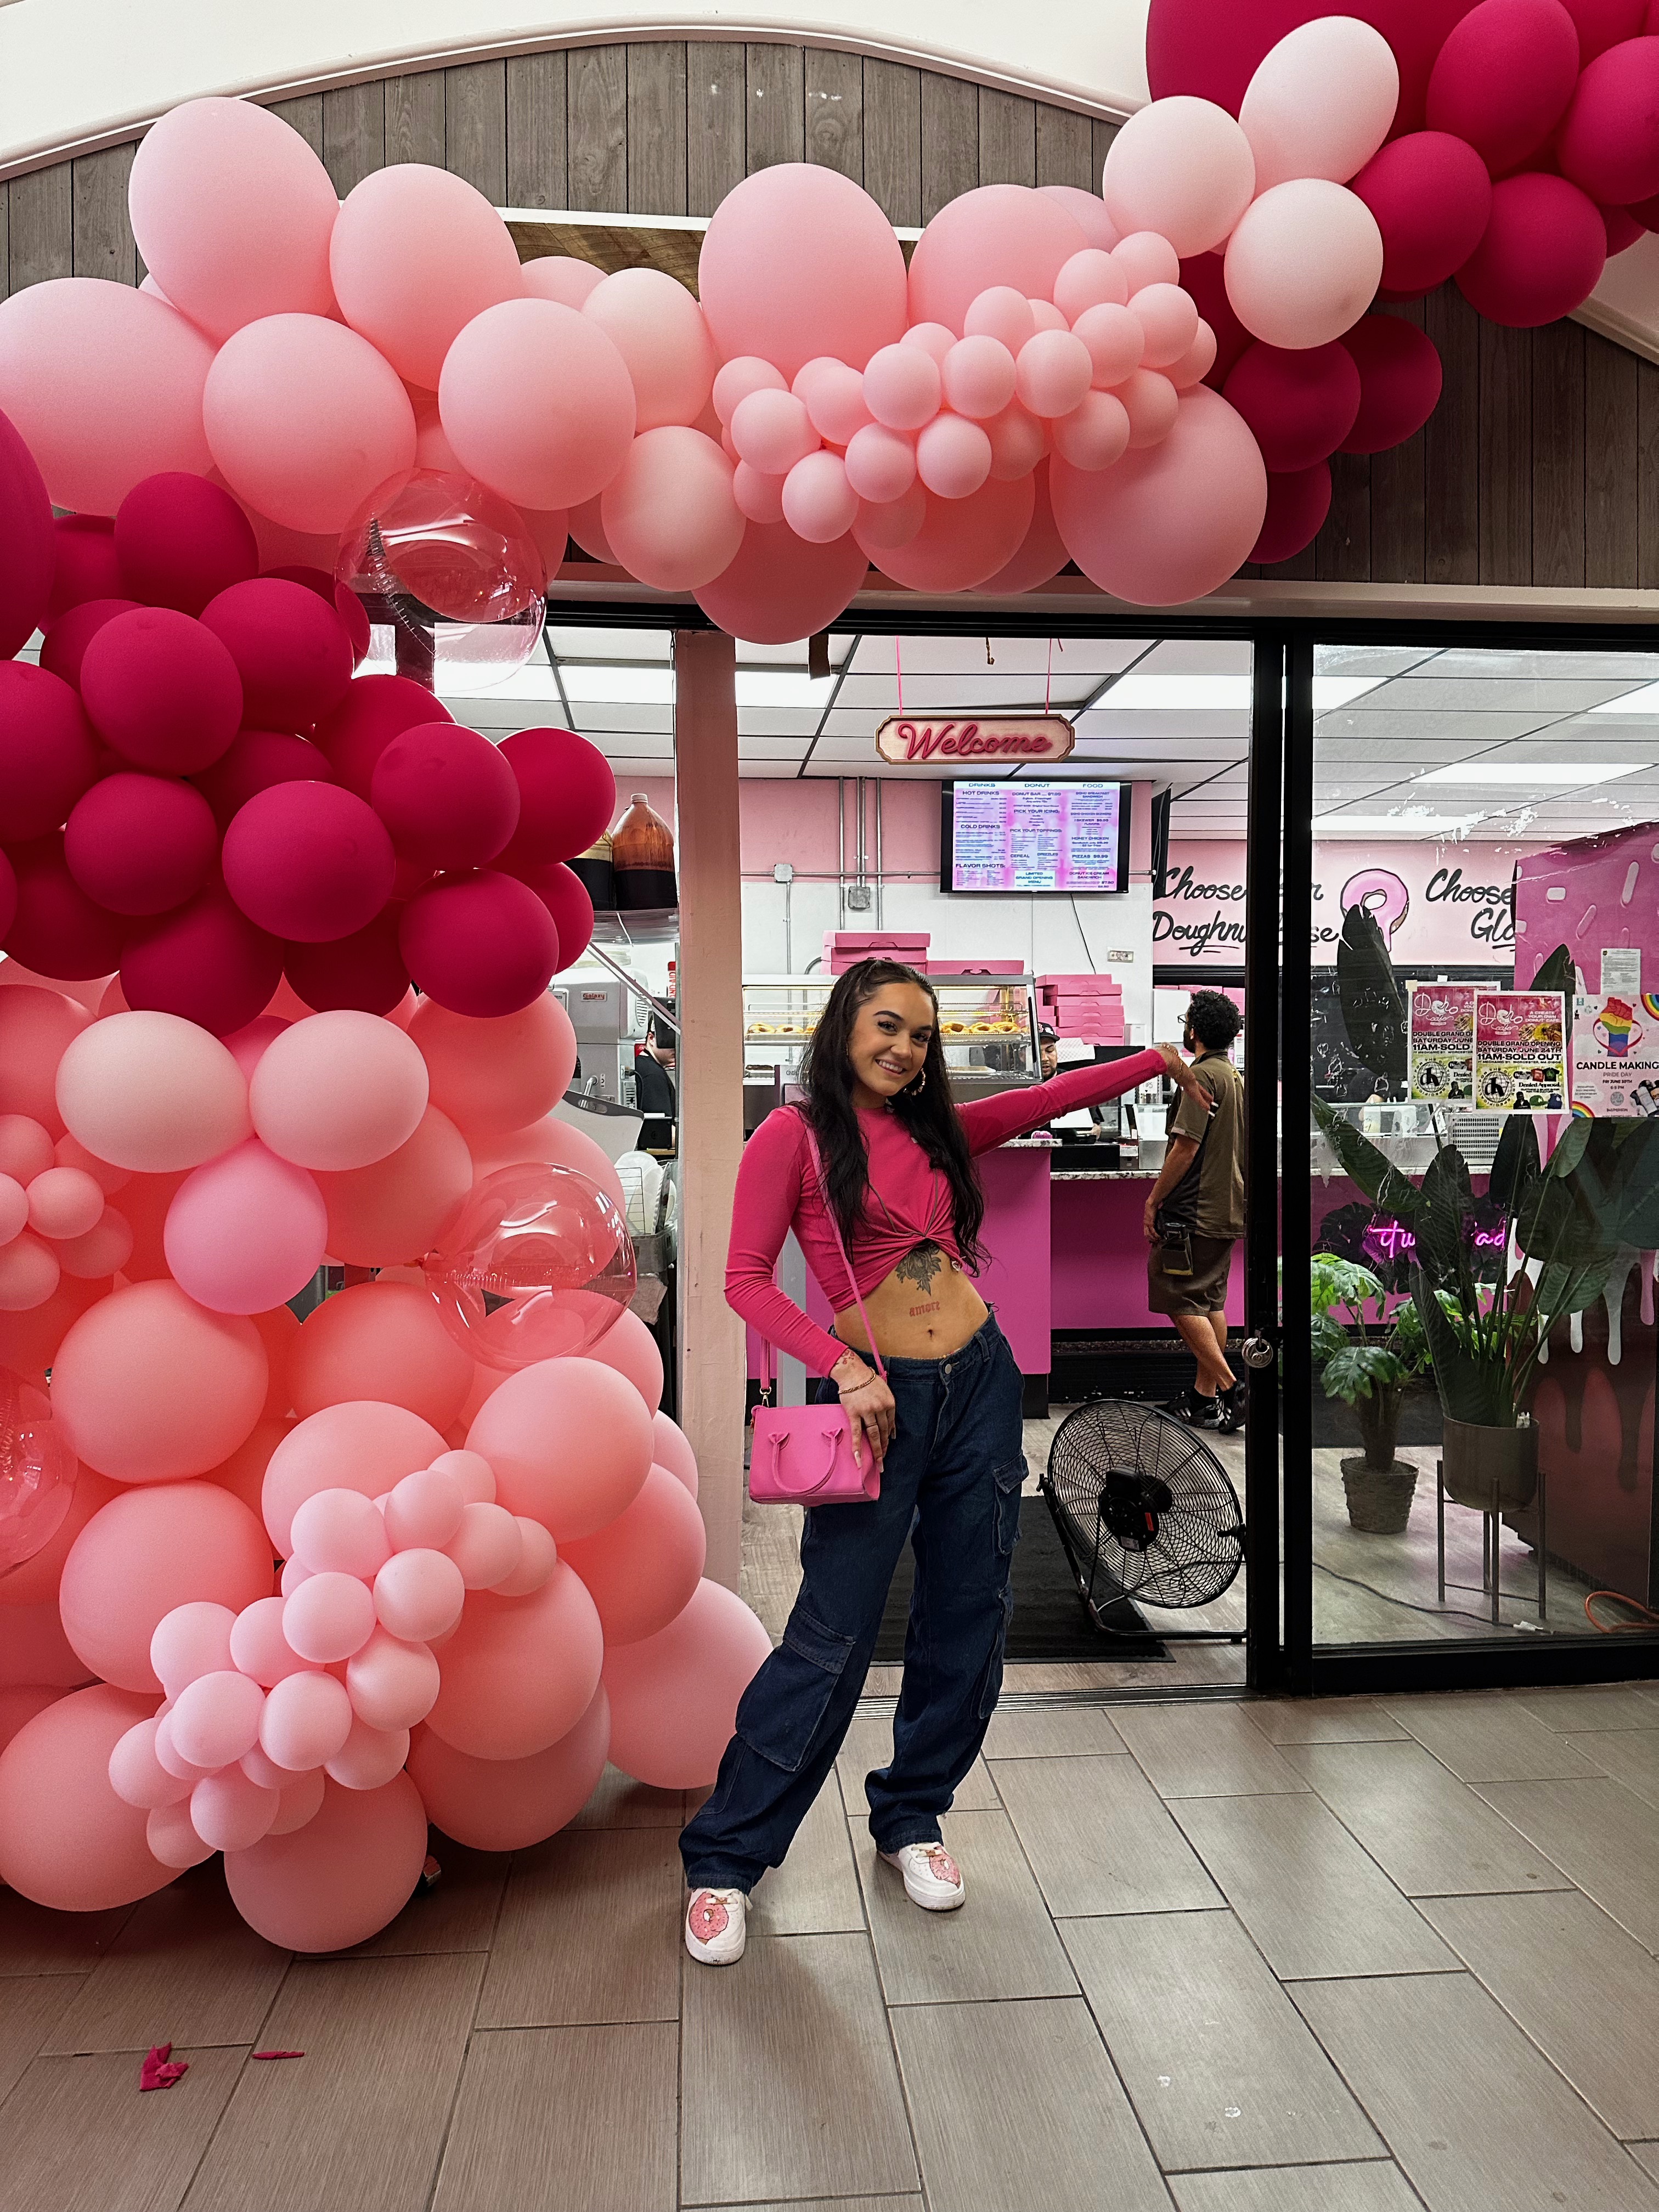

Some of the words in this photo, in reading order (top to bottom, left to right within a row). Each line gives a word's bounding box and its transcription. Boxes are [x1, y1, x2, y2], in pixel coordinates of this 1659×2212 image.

[898, 724, 1053, 759] Welcome
[1165, 866, 1247, 901] Choose
[1426, 868, 1513, 905] Choose
[1153, 910, 1246, 956] Doughnu
[1471, 907, 1515, 942] Gla
[1619, 1062, 1658, 1070] MAKING
[909, 1301, 940, 1317] amore
